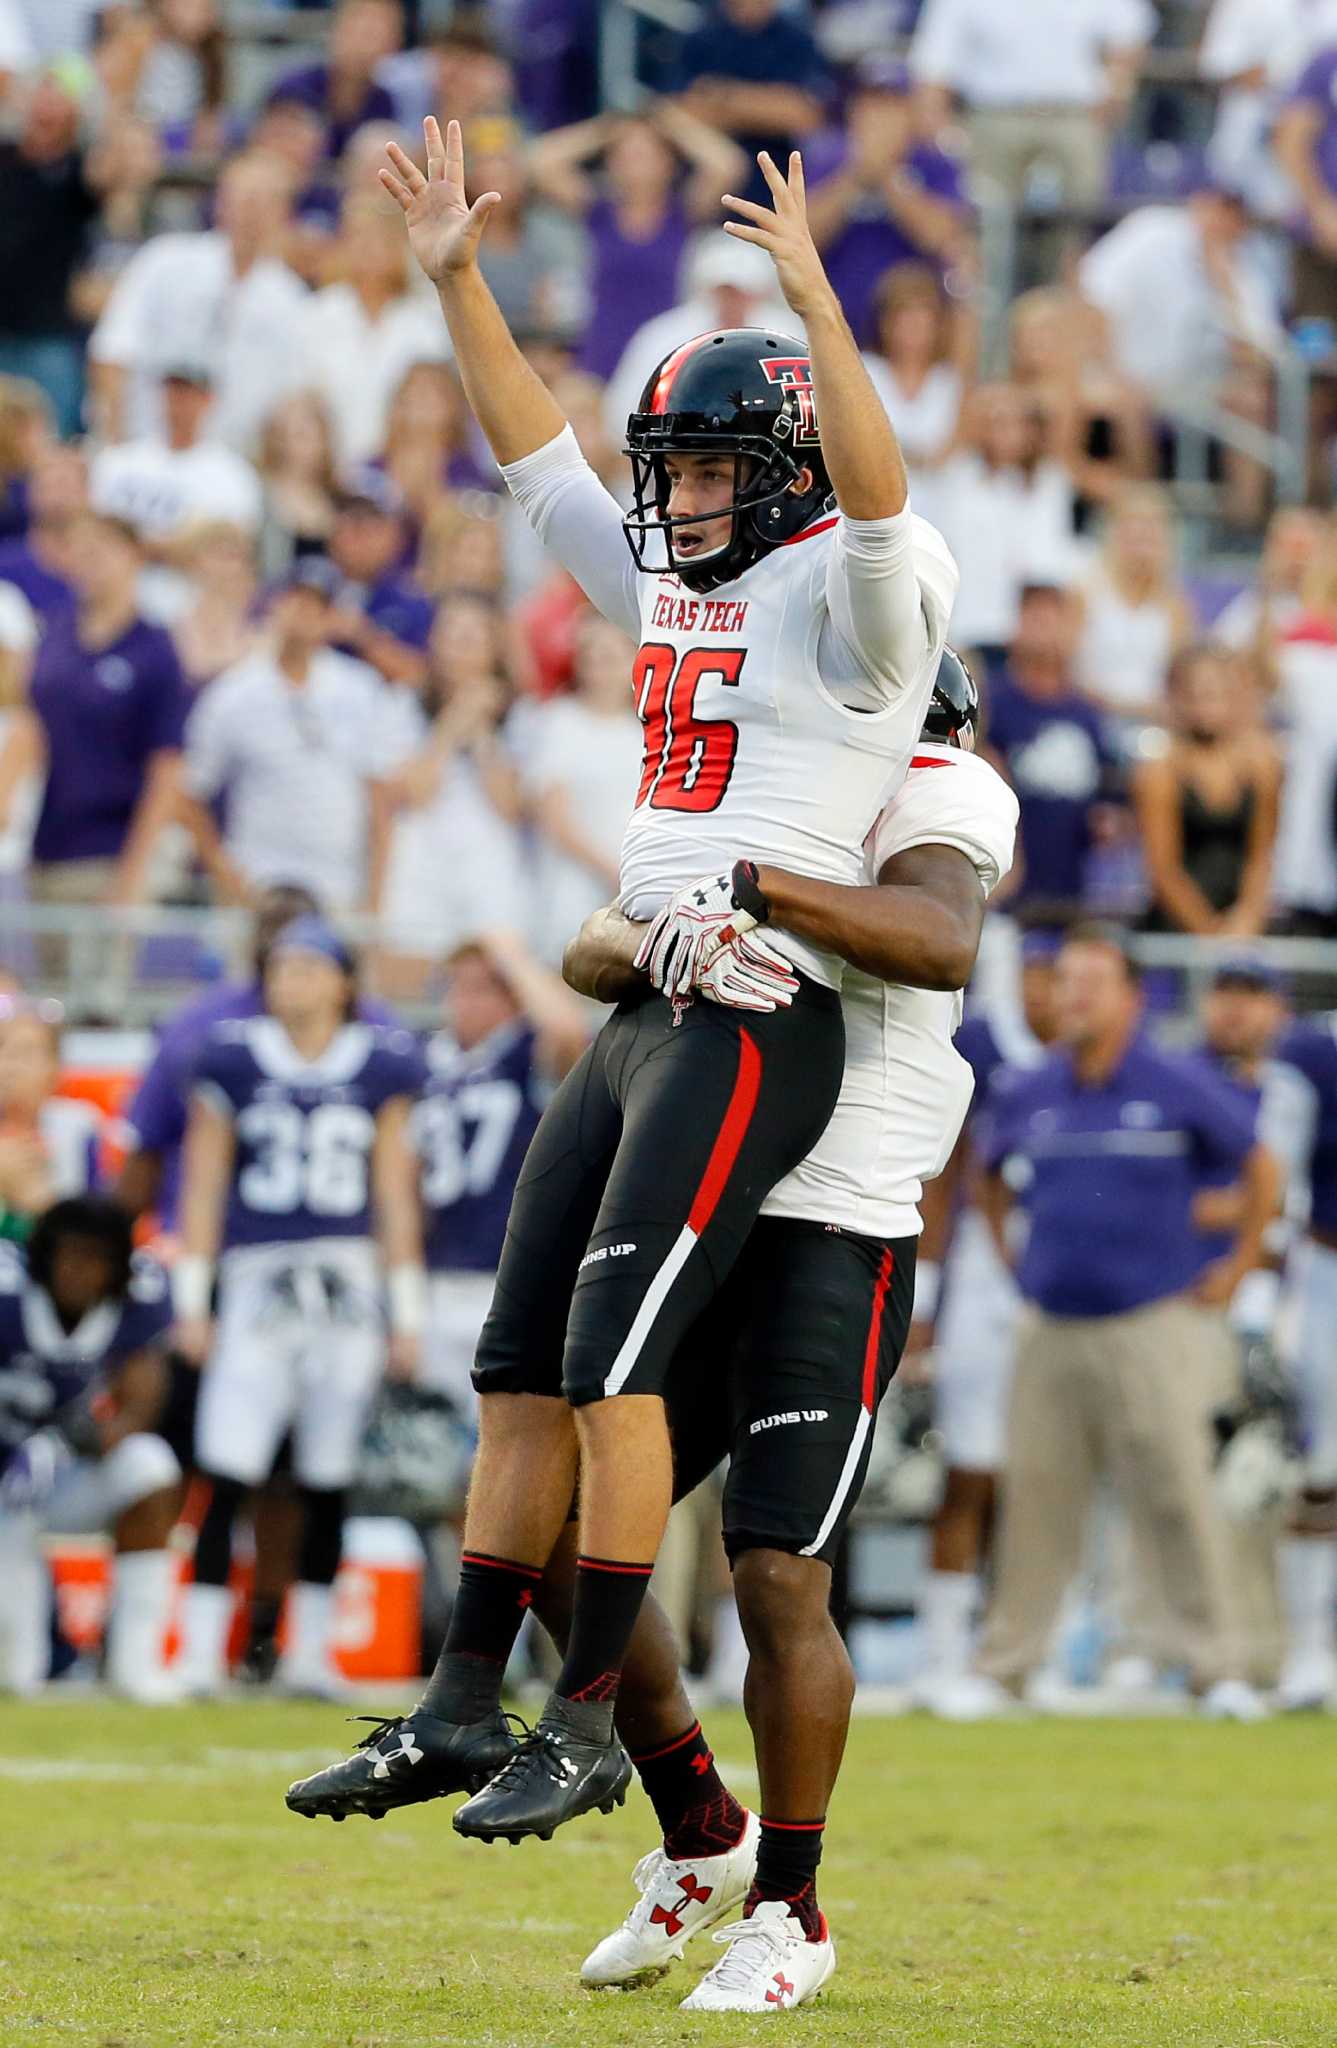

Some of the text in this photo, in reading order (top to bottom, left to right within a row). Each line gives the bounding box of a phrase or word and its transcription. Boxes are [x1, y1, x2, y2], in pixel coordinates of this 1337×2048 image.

[651, 593, 748, 632] TEXAS TECH
[632, 641, 748, 813] 96
[237, 1098, 376, 1217] 36
[578, 1243, 637, 1272] UNS UP
[750, 1409, 829, 1434] GUNS UP
